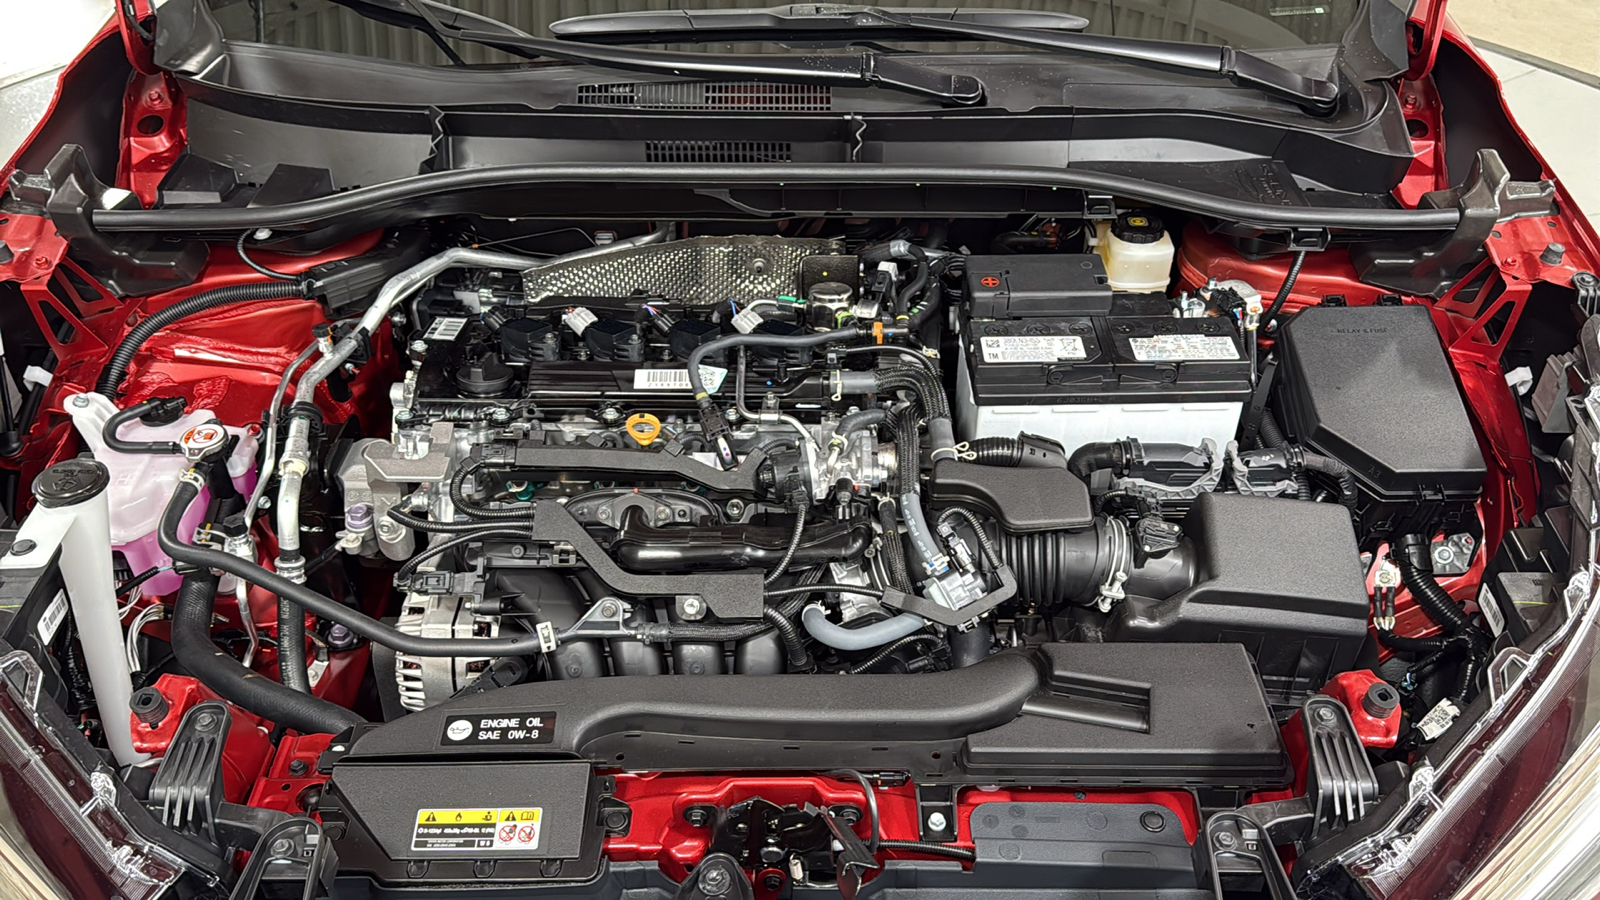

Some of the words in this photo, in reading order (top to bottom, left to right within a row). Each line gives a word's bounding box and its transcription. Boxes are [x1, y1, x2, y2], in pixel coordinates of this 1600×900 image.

[480, 718, 520, 728] ENGINE
[526, 717, 544, 727] OIL
[478, 730, 501, 740] SAE
[507, 730, 539, 740] 0W-8
